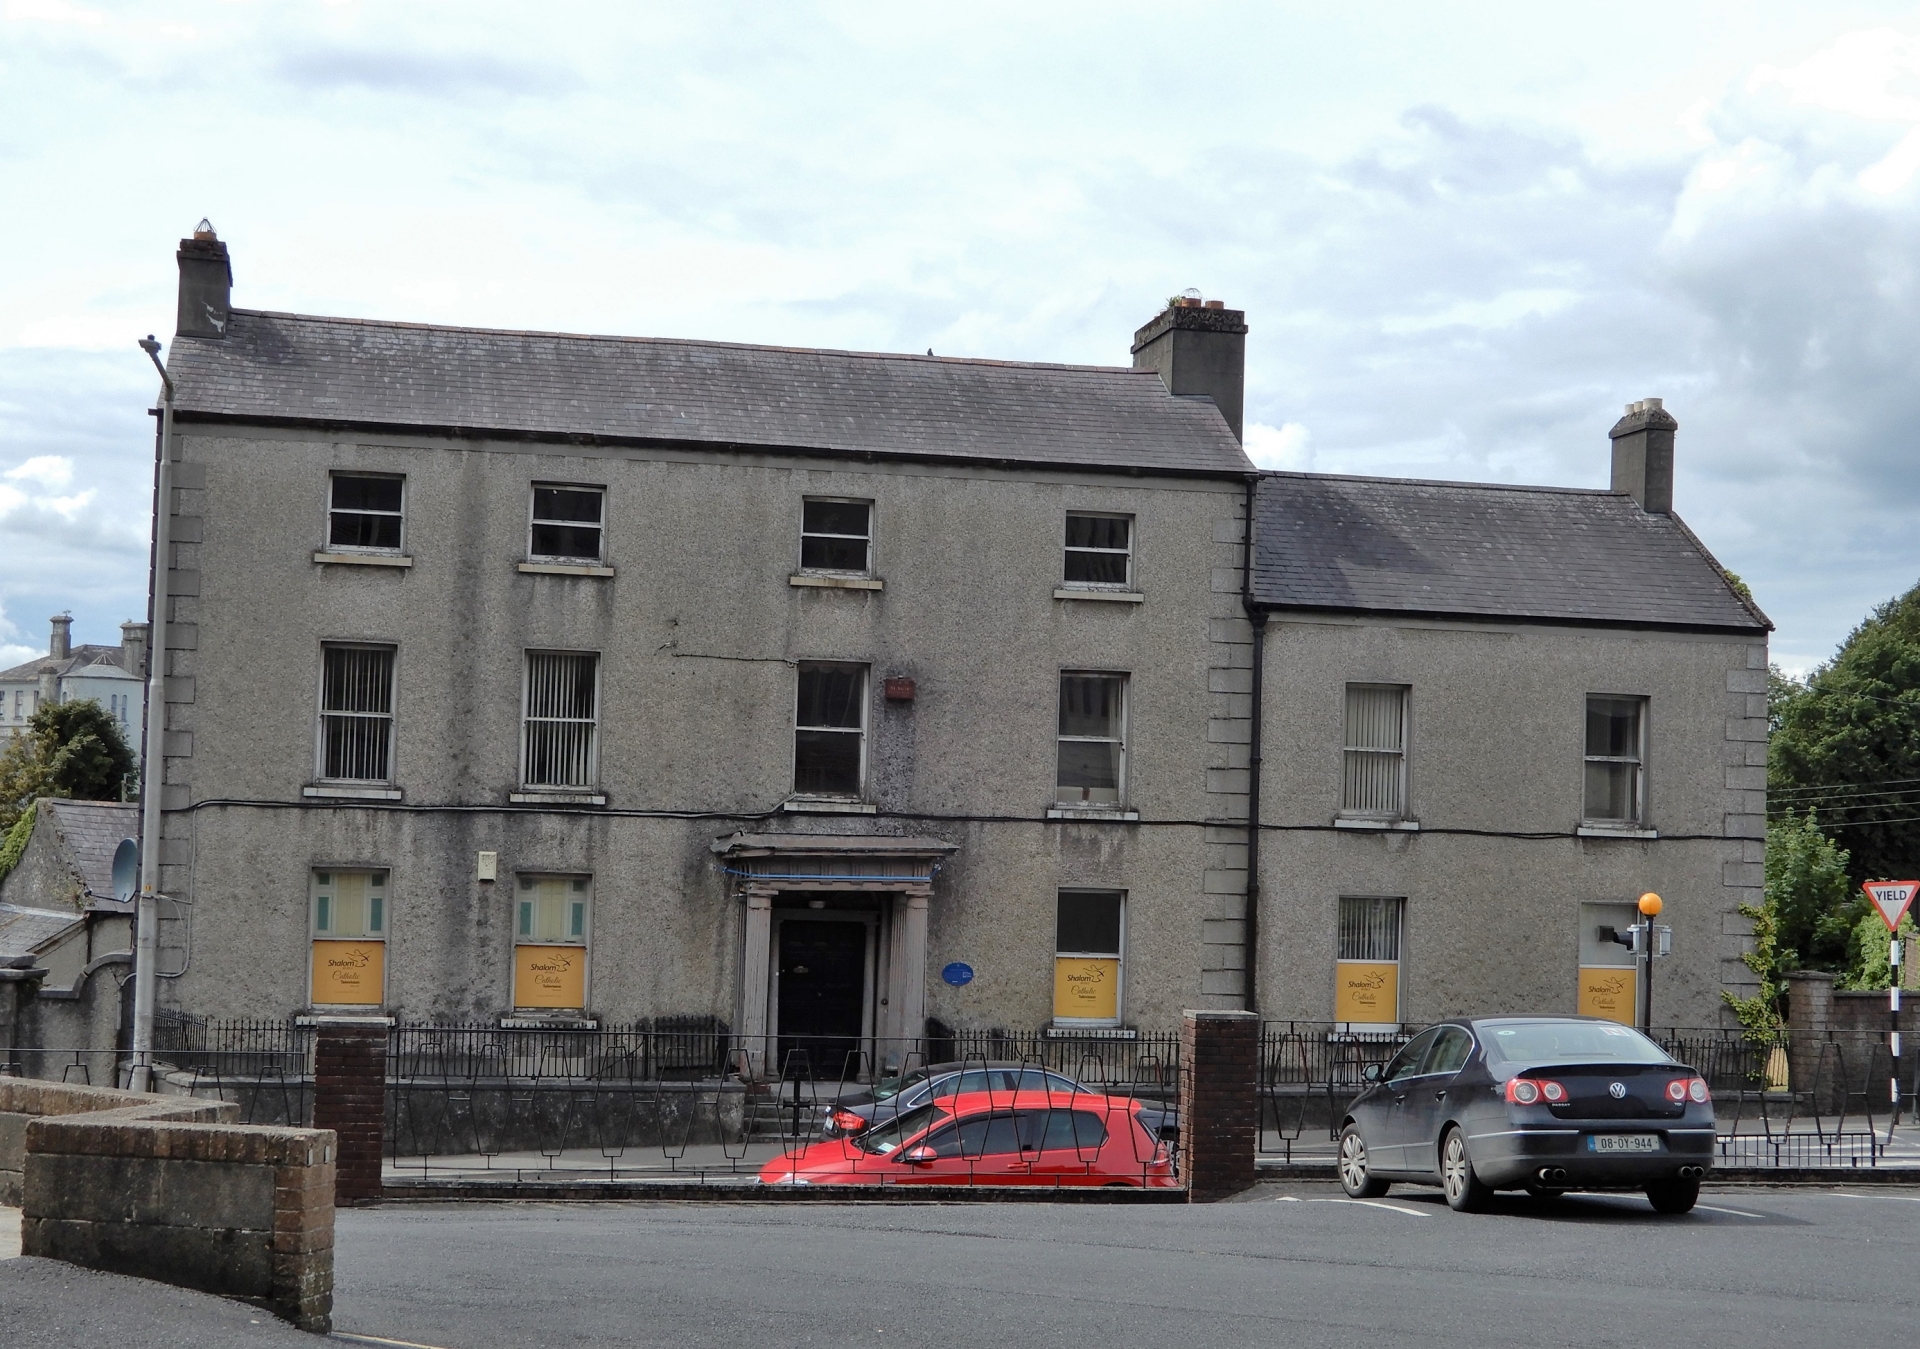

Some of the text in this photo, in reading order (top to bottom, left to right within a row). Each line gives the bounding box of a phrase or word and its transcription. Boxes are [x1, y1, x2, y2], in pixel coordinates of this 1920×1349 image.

[1876, 890, 1907, 900] YIELD
[328, 959, 354, 967] Shalom
[530, 963, 557, 971] Shalom
[332, 970, 360, 980] Catholic
[534, 974, 562, 984] Catholic
[1067, 974, 1091, 982] Shalom
[1070, 985, 1096, 995] Catholic
[1601, 1138, 1652, 1149] 08-OY-944
